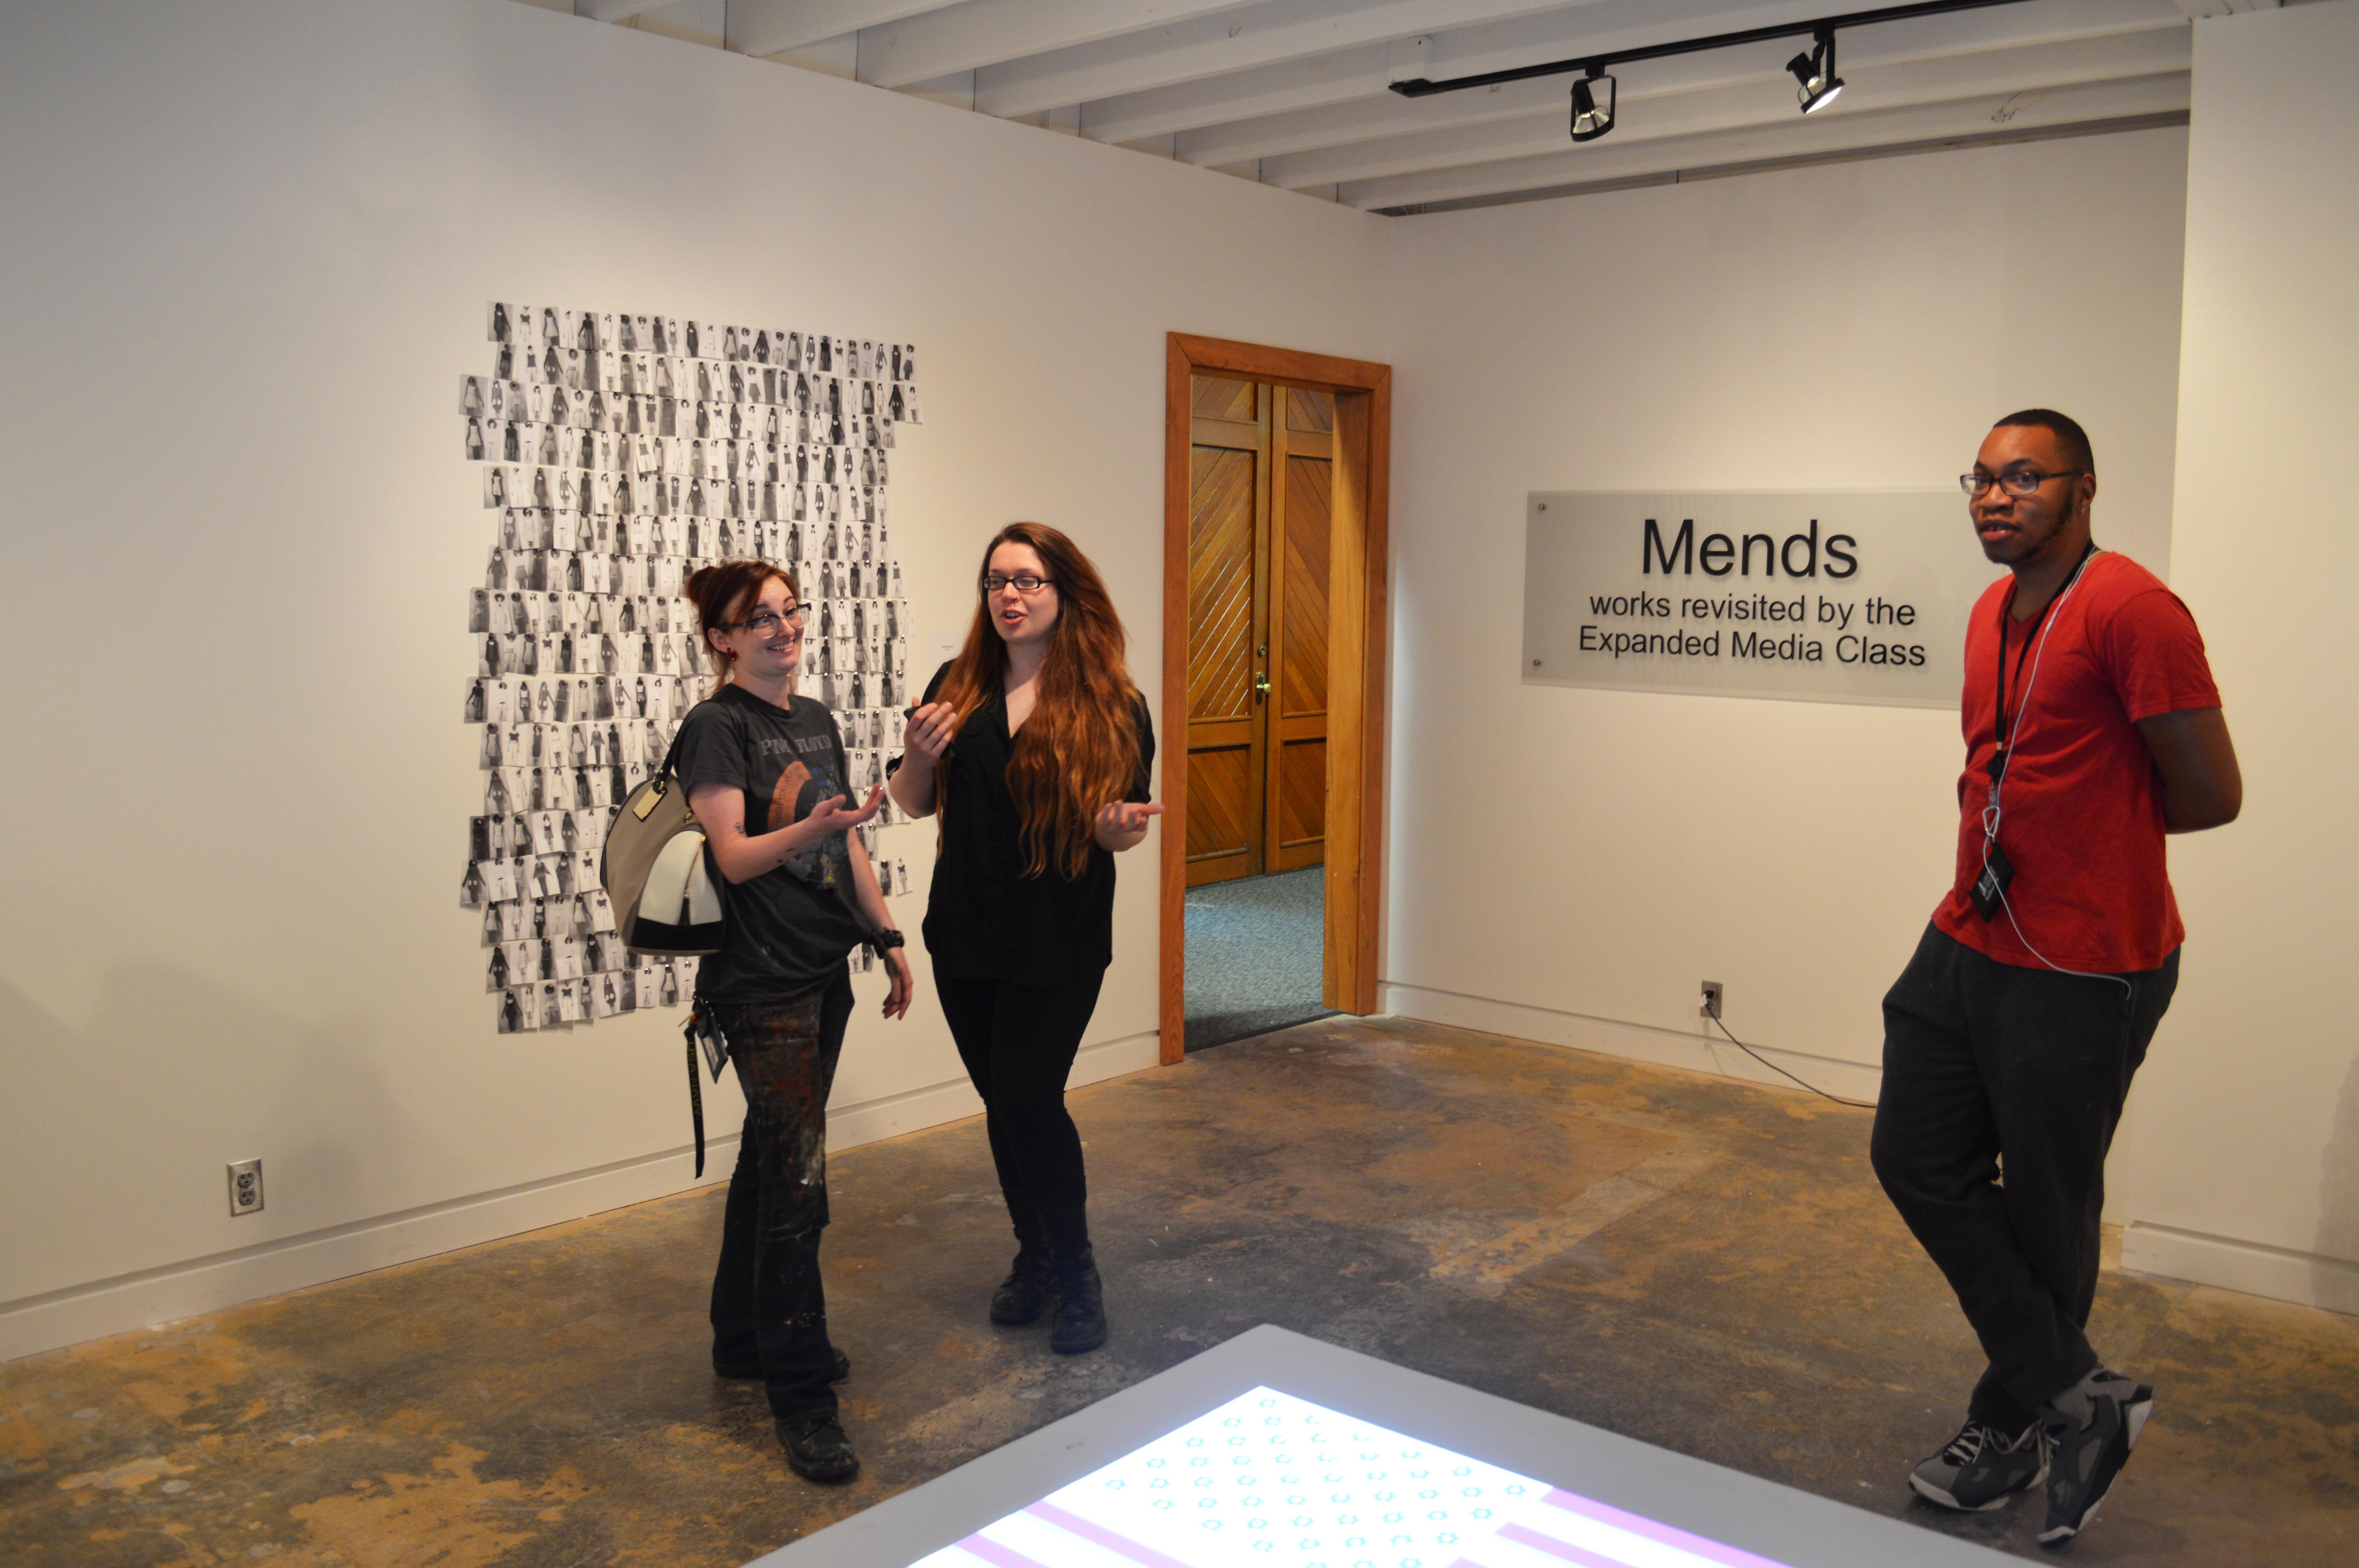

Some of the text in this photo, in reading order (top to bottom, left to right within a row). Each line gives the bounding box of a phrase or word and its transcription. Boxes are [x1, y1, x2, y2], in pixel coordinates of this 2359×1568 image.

[1643, 519, 1858, 579] Mends
[1590, 591, 1916, 631] works revisited by the
[1579, 625, 1926, 667] Expanded Media Class
